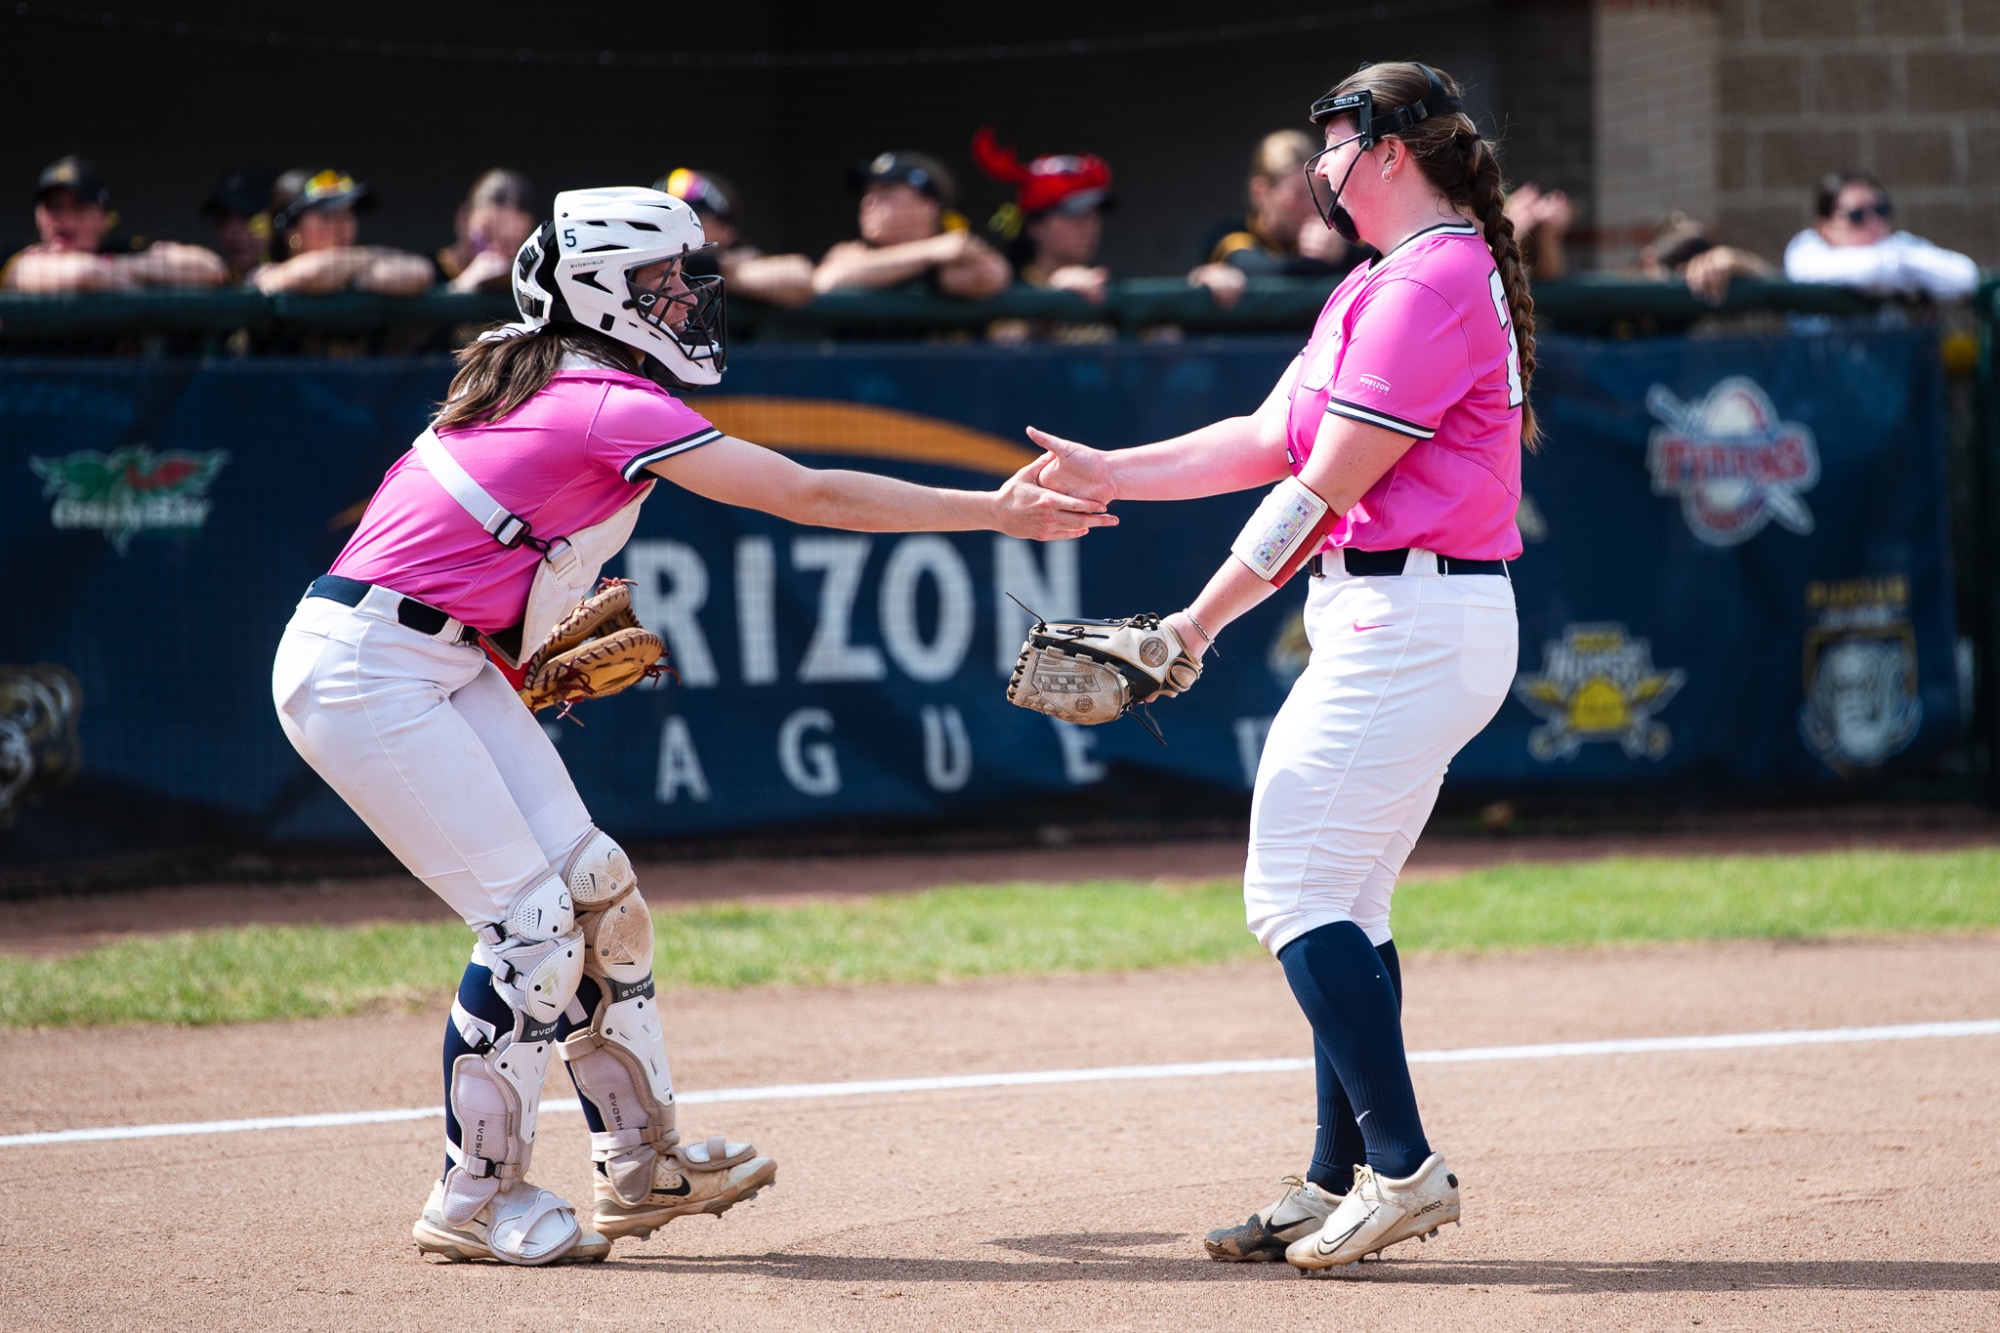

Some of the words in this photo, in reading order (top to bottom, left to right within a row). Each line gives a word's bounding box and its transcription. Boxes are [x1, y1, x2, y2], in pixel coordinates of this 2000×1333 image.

[564, 228, 577, 248] 5
[1359, 376, 1391, 392] HORIZON
[625, 534, 1082, 690] RIZON
[655, 704, 1107, 802] AGUE
